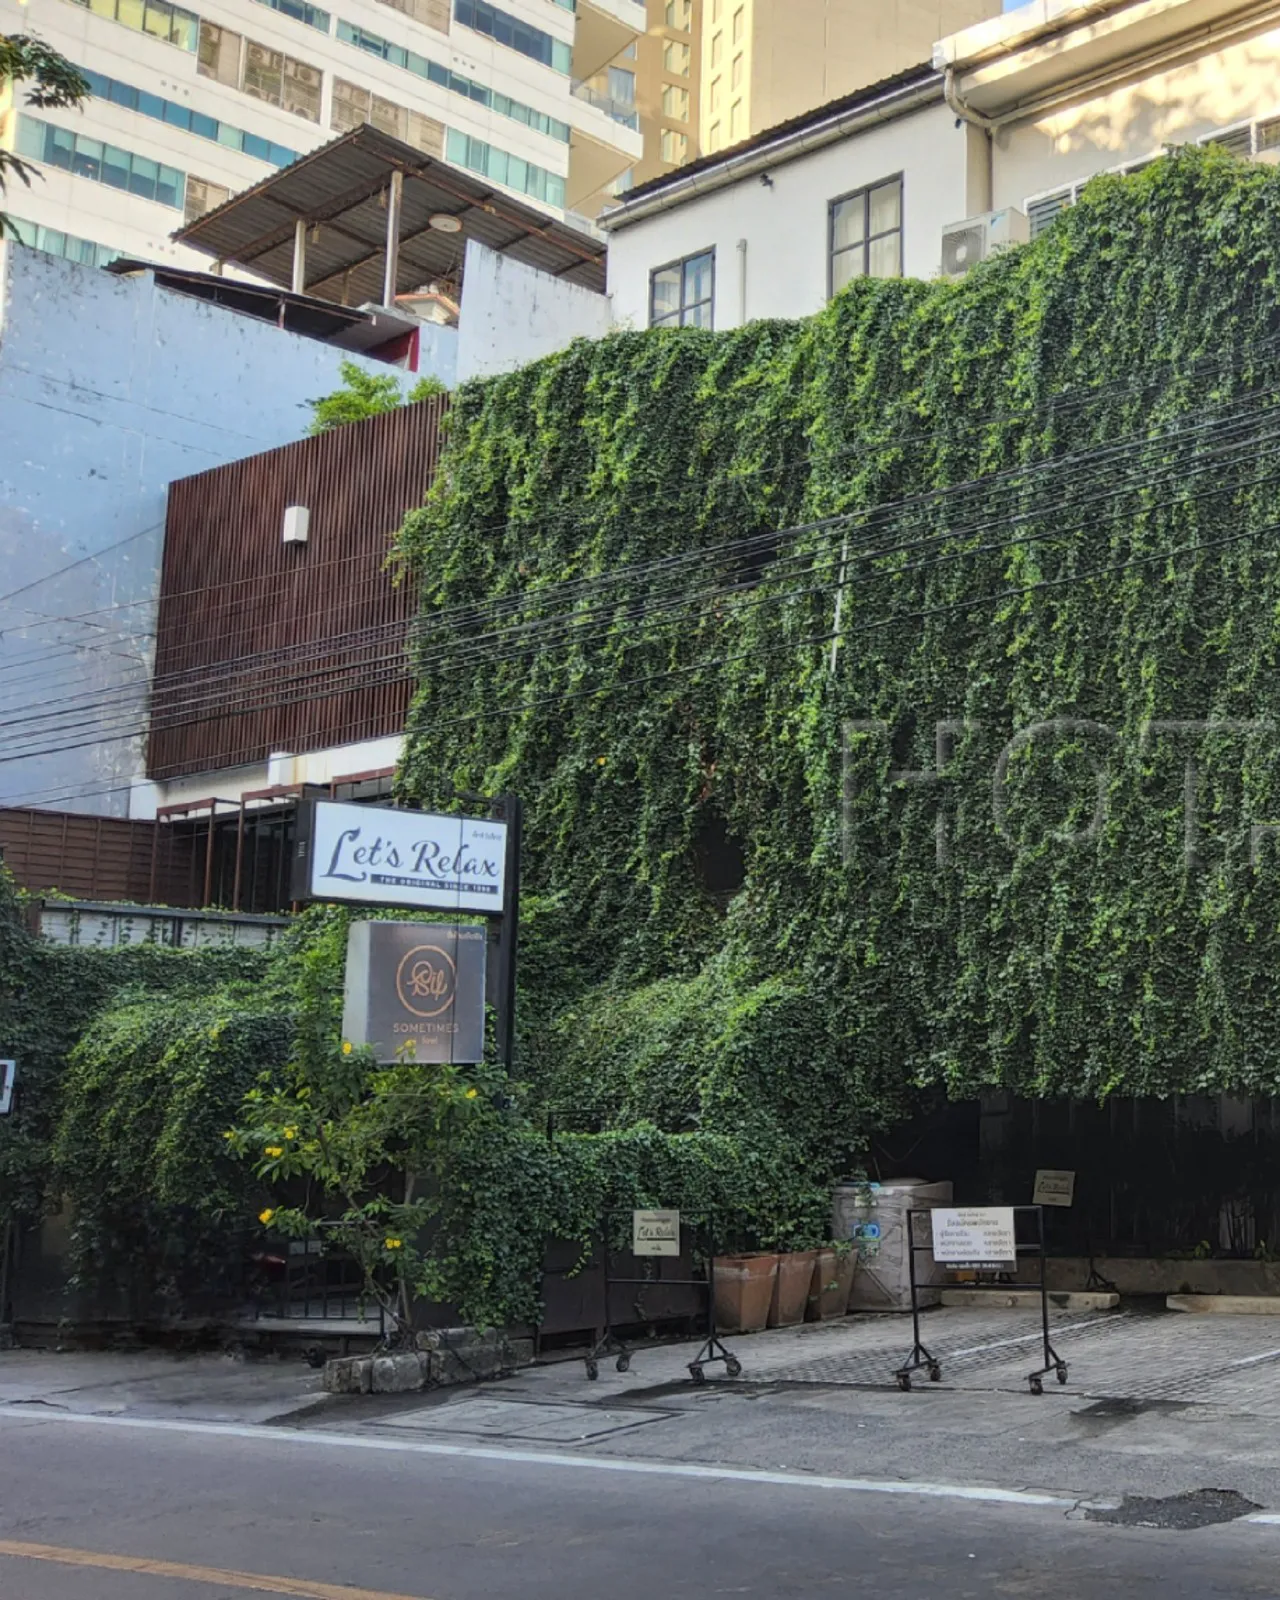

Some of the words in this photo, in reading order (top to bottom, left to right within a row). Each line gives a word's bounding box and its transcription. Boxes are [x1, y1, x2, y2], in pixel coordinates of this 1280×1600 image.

[320, 827, 404, 882] Let's
[411, 840, 500, 879] Relax
[380, 876, 396, 885] THE
[400, 877, 441, 889] ORIGINAL
[393, 1023, 459, 1033] SOMETIMES
